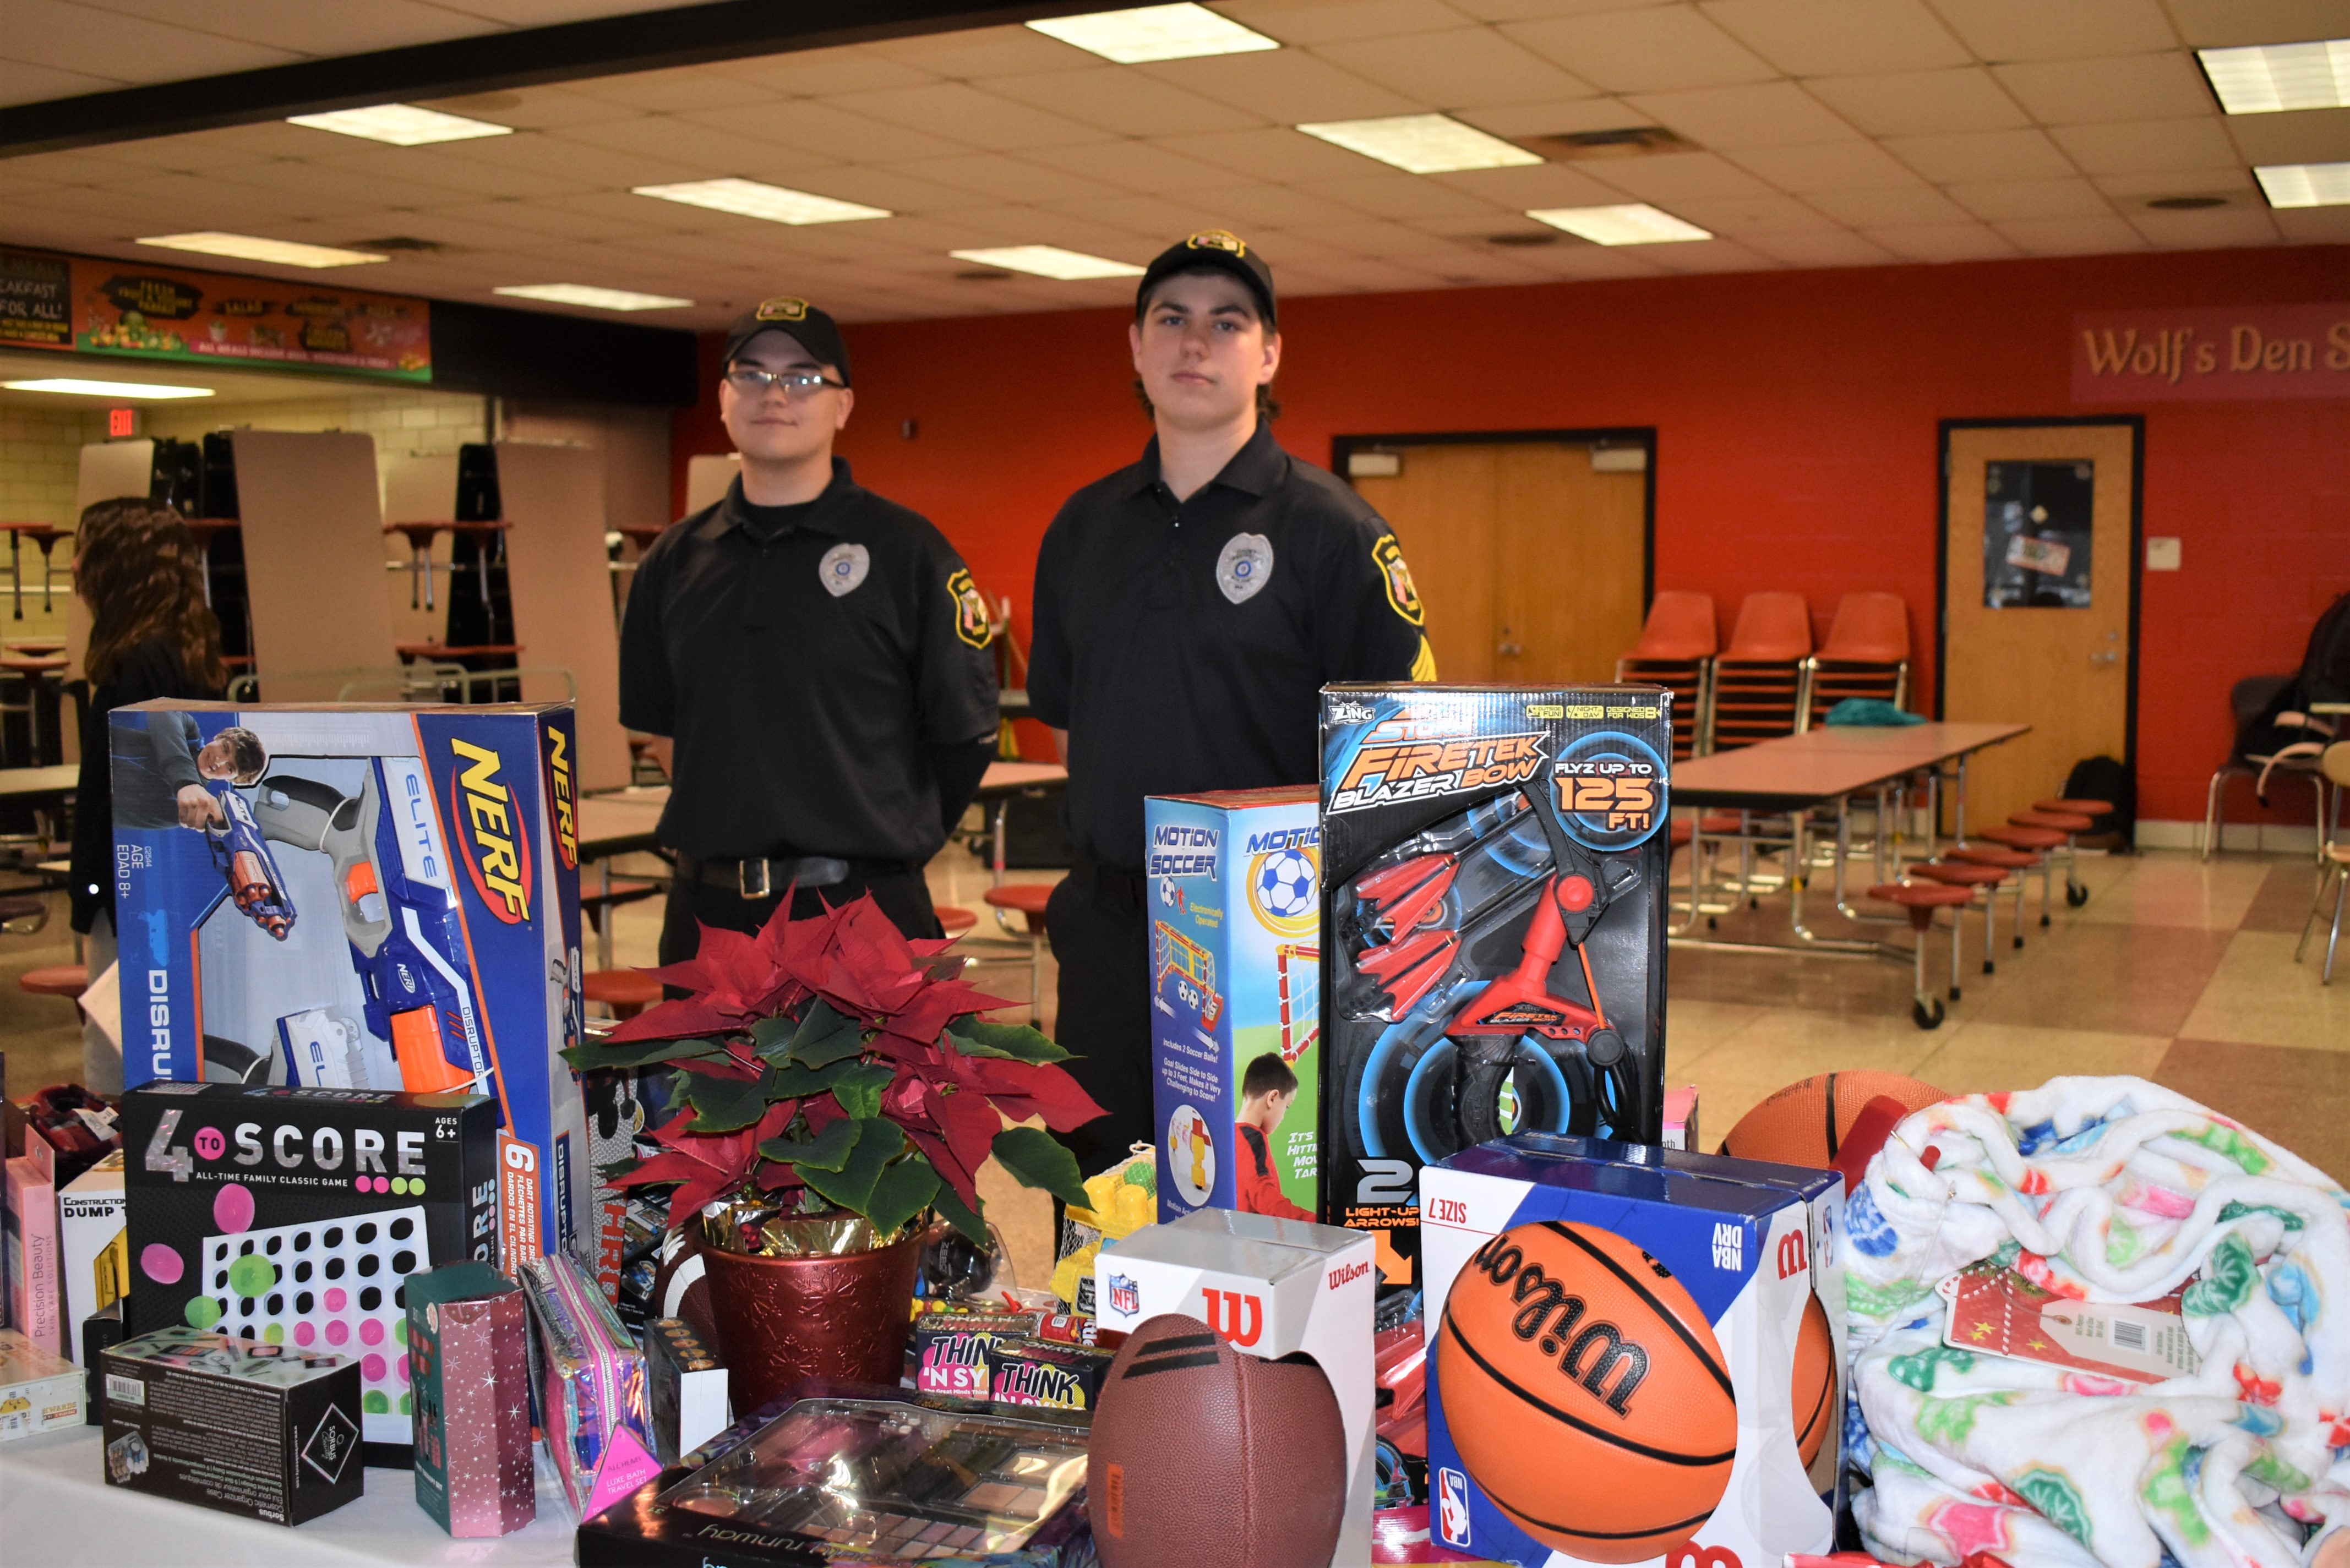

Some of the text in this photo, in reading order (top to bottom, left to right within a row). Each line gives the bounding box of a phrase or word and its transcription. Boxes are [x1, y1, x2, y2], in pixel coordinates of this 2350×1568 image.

[2084, 326, 2216, 384] Wolf's
[2229, 325, 2312, 372] Den
[1555, 763, 1652, 774] FLYZ UP TO
[548, 725, 579, 866] NERF
[1332, 758, 1537, 810] BLAZER BOW
[1554, 777, 1653, 810] 125
[406, 773, 438, 879] ELITE
[451, 738, 531, 922] NERF
[1609, 812, 1650, 829] FT!
[131, 844, 144, 868] AGE
[1149, 854, 1218, 882] SOCCER
[117, 844, 130, 899] EDAD 8+
[1190, 902, 1224, 920] Electronically
[1195, 914, 1219, 928] Operated
[397, 963, 415, 993] NERF
[149, 970, 172, 1080] DISRU
[1163, 1037, 1218, 1063] Includes 2 Soccer Balls!
[1162, 1067, 1168, 1077] up
[1177, 1072, 1188, 1084] Feet,
[1189, 1076, 1204, 1089] Makes
[1205, 1081, 1209, 1090] it
[1210, 1083, 1222, 1096] Very
[1164, 1057, 1218, 1083] Goal Slides Side to Side
[291, 1089, 395, 1101] SCORE
[1166, 1077, 1215, 1102] Challenging to Score!
[435, 1117, 457, 1125] AGES
[435, 1125, 456, 1139] 6+
[145, 1109, 427, 1182] 4 TO SCORE
[505, 1143, 534, 1172] 6
[195, 1172, 348, 1187] ALL-TIME FAMILY CLASSIC GAME
[1356, 1159, 1414, 1204] 2
[64, 1206, 114, 1217] DUMP
[516, 1174, 526, 1225] FLÉCHETTES
[1167, 1199, 1181, 1212] Motion
[1345, 1206, 1419, 1217] LIGHT-UP
[1428, 1197, 1467, 1225] SIZE 7
[507, 1171, 517, 1274] DARDOS EN EL CILINDRO
[1344, 1217, 1420, 1227] ARROWS!
[1712, 1223, 1742, 1248] DRV
[46, 1234, 54, 1285] SOLUTIONS
[1712, 1245, 1742, 1271] NBA
[31, 1234, 46, 1337] Precision Beauty
[1328, 1260, 1370, 1290] Wilson
[1111, 1285, 1139, 1311] NFL
[1473, 1234, 1650, 1419] Wilson
[923, 1368, 947, 1387] 'N
[1002, 1362, 1079, 1405] THINK
[321, 1431, 331, 1461] Beauty
[172, 1457, 206, 1469] compartiments
[190, 1469, 224, 1482] Compartments
[212, 1466, 225, 1474] Daisy
[608, 1456, 642, 1472] ALCHEMY
[241, 1480, 257, 1489] Design
[255, 1477, 282, 1488] Conception
[606, 1468, 646, 1487] LUXE BATH
[607, 1476, 647, 1495] TRAVEL SET
[1449, 1474, 1463, 1489] NBA
[206, 1488, 284, 1513] Cosmetic Organizer Case
[223, 1484, 257, 1497] organisateur
[269, 1487, 282, 1495] Daisy
[259, 1509, 285, 1522] Sorbus
[697, 1523, 805, 1551] runway
